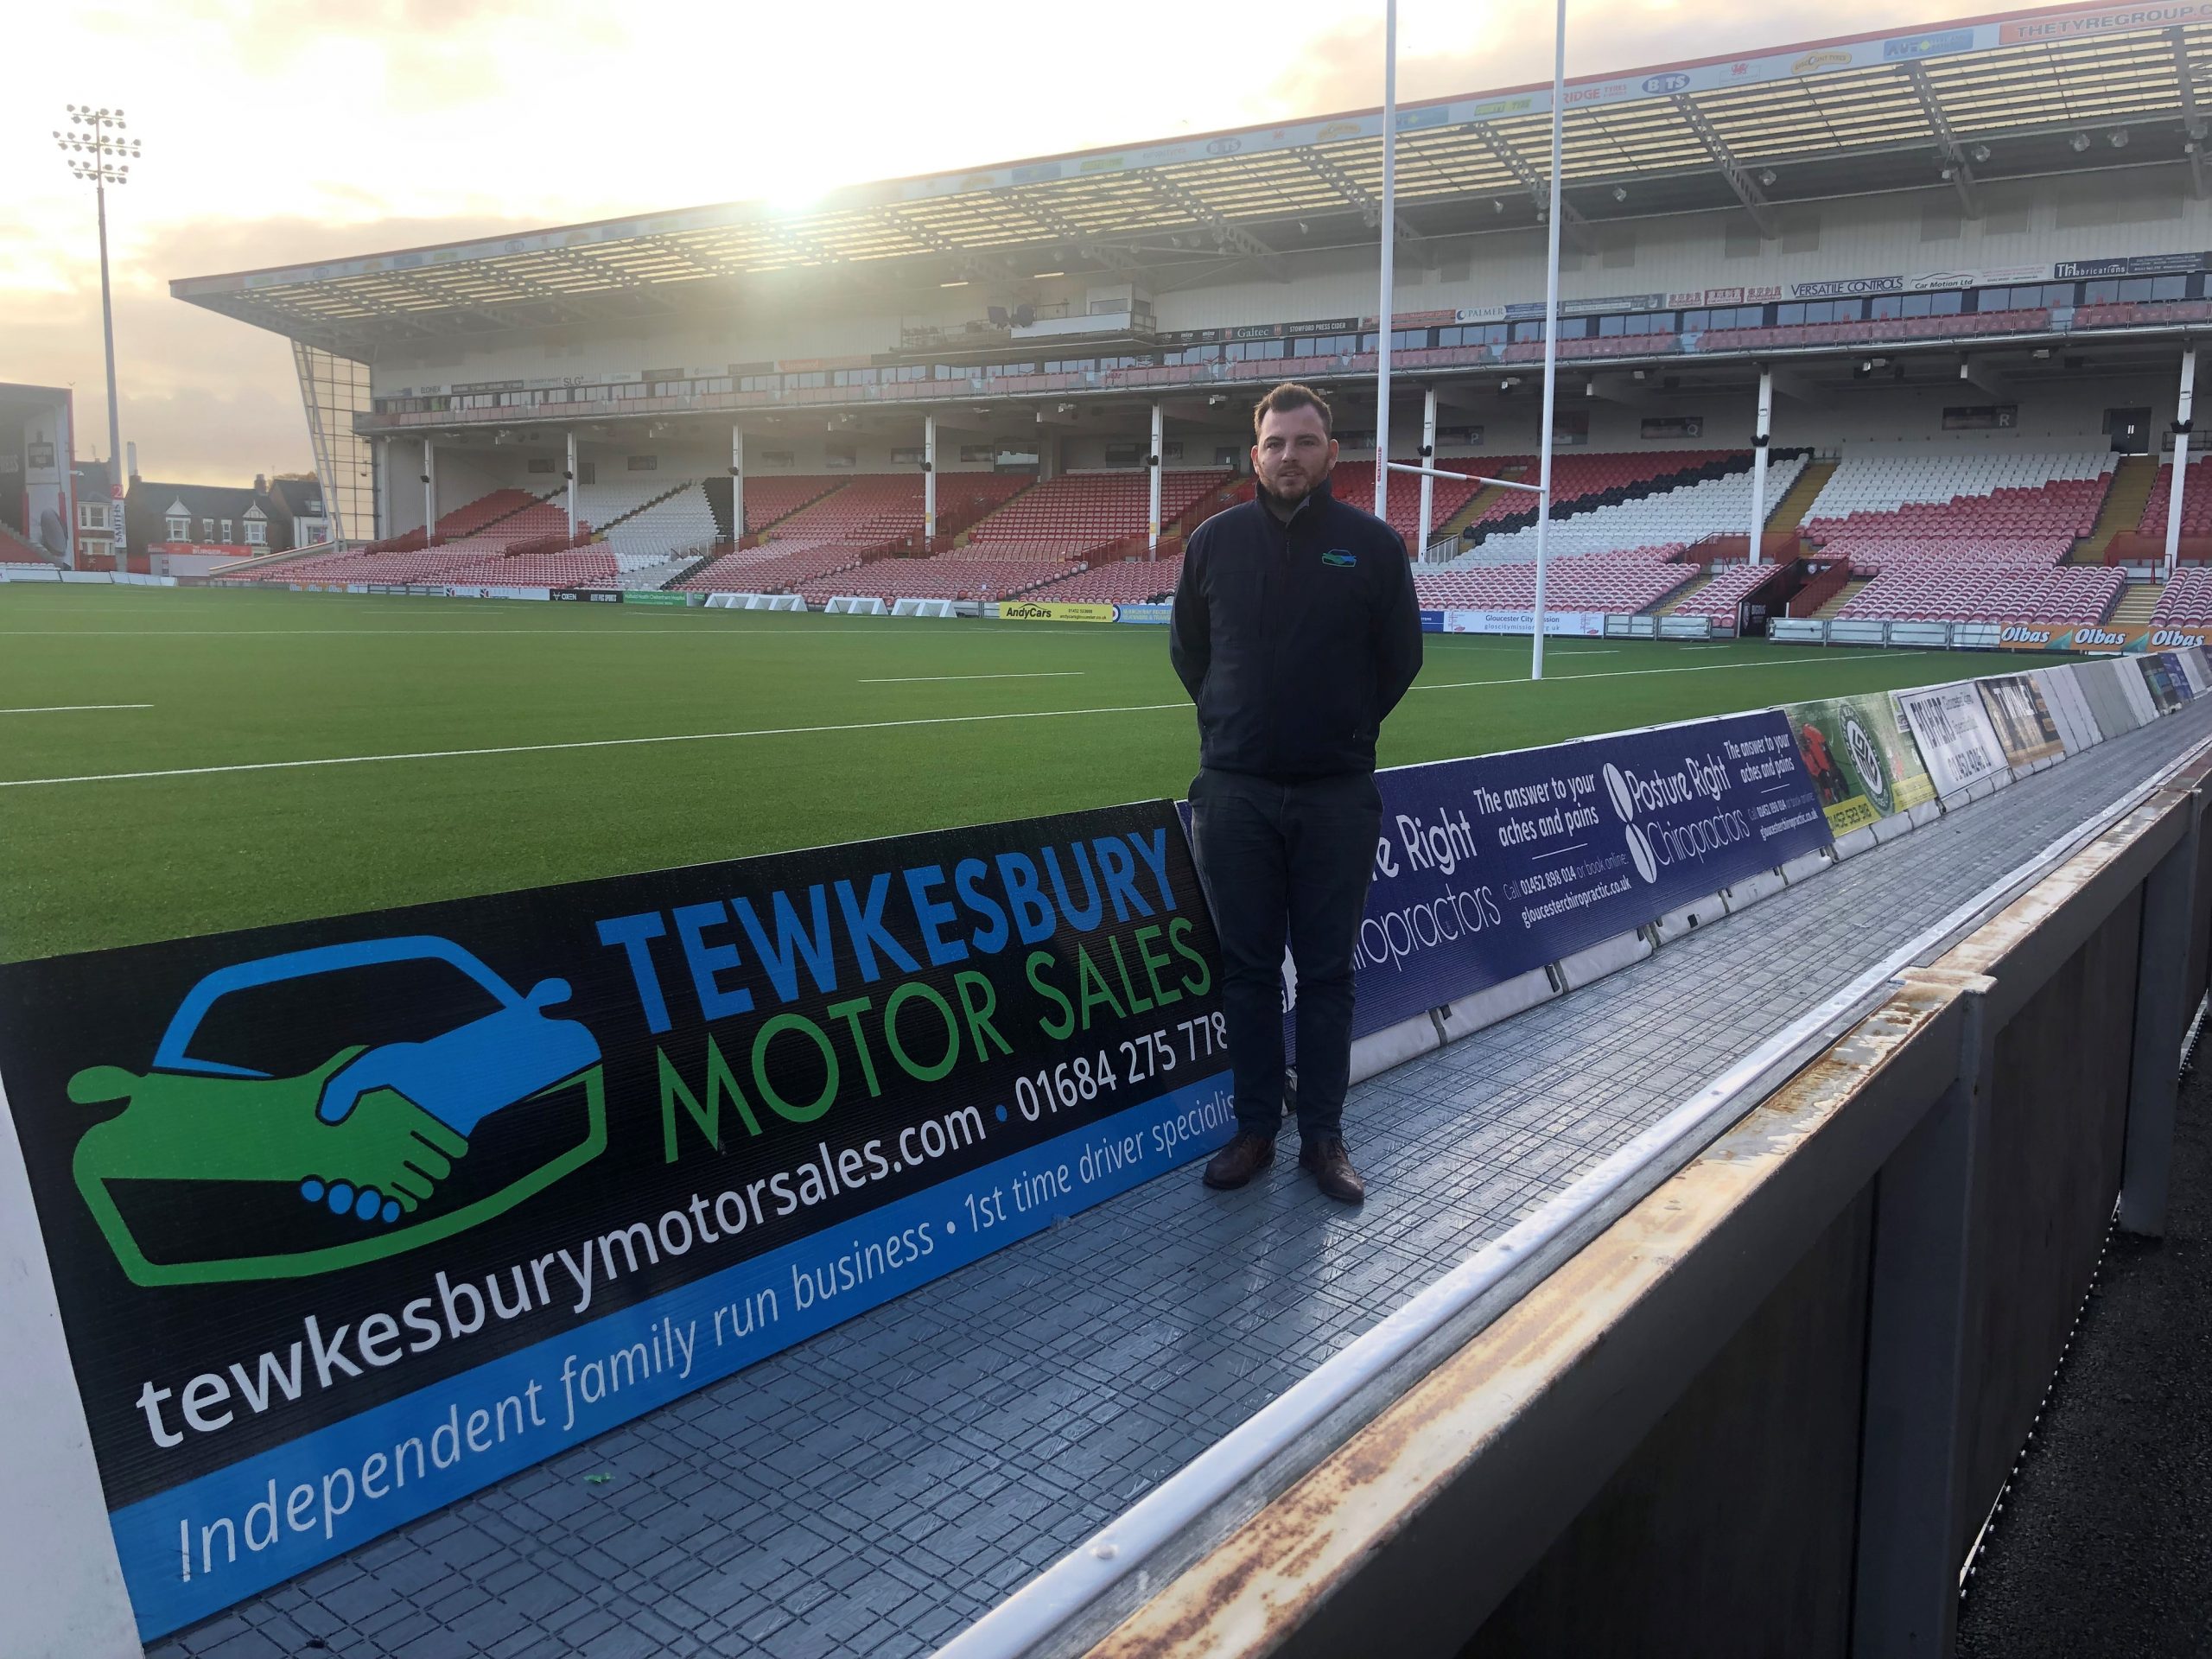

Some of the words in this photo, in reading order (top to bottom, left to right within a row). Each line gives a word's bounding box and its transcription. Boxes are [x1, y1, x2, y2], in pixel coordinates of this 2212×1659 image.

[1790, 279, 1844, 296] VERSATILE
[1847, 276, 1904, 292] CONTROLS
[1929, 280, 1959, 289] Motion
[1960, 278, 1974, 287] Ltd
[1289, 324, 1314, 333] STOWFORD
[1315, 323, 1330, 332] PRESS
[1331, 322, 1346, 331] CIDER
[1468, 308, 1503, 318] PALMER
[1237, 327, 1269, 338] Galtec
[1999, 413, 2010, 427] R
[113, 504, 124, 543] SMITHS
[1006, 607, 1052, 619] AndyCars
[1520, 614, 1534, 625] City
[2001, 626, 2050, 643] Olbas
[2075, 628, 2126, 645] Olbas
[2152, 630, 2205, 646] Olbas
[1724, 740, 1742, 760] The
[1740, 739, 1766, 757] answer
[1764, 734, 1775, 751] to
[1773, 734, 1790, 753] your
[1624, 769, 1693, 813] Posture
[1685, 753, 1732, 801] Right
[1740, 762, 1763, 784] aches
[1761, 757, 1777, 778] and
[1775, 753, 1796, 779] pains
[1472, 786, 1503, 815] The
[1503, 782, 1551, 810] answer
[1551, 777, 1567, 799] to
[1567, 773, 1596, 803] your
[1498, 817, 1537, 847] aches
[1538, 807, 1564, 837] and
[1564, 802, 1599, 837] pains
[1647, 806, 1751, 866] Chiropractors
[1395, 807, 1478, 875] Right
[1503, 880, 1520, 900] Call
[1520, 874, 1546, 896] 01452
[1545, 869, 1562, 888] 898
[1561, 865, 1577, 884] 014
[1576, 865, 1585, 879] or
[1584, 856, 1605, 876] book
[1521, 874, 1631, 929] gloucesterchiropractic.co.uk
[596, 828, 1177, 1034] TEWKESBURY
[657, 970, 1014, 1164] MOTOR
[1026, 918, 1211, 1039] SALES
[136, 1103, 987, 1448] tewkesburymotorsales.com
[1014, 1047, 1118, 1122] 01684
[1119, 1029, 1177, 1084] 275
[178, 1378, 546, 1583] Independent
[560, 1317, 696, 1431] family
[714, 1286, 779, 1346] run
[791, 1220, 935, 1312] business
[963, 1186, 1007, 1234] 1st
[1012, 1159, 1072, 1211] time
[1079, 1128, 1146, 1185] driver
